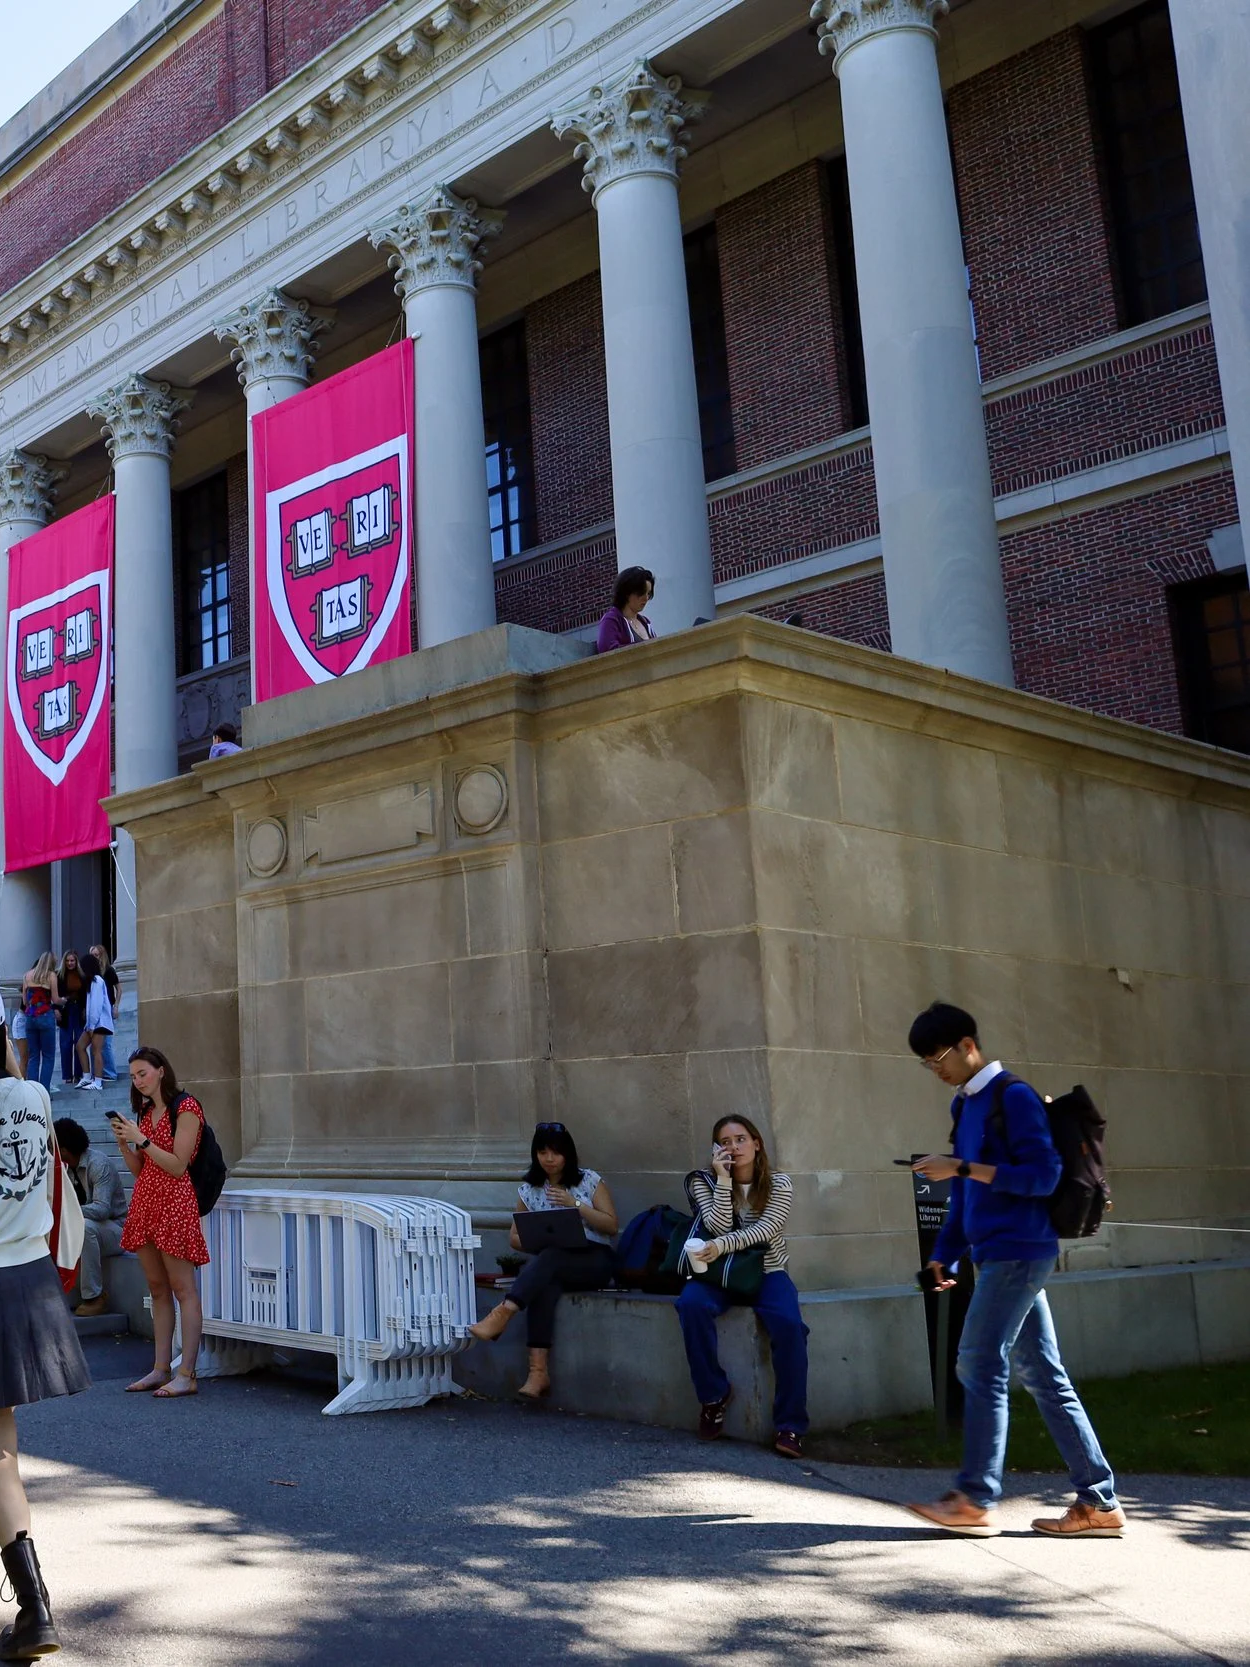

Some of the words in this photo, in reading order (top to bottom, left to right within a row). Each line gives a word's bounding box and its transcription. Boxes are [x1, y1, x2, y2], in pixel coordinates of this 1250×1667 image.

[31, 262, 209, 401] MEMORIAL
[239, 107, 431, 263] LIBRARY
[298, 527, 324, 555] VE
[356, 504, 379, 535] RI
[326, 592, 358, 624] TAS
[27, 640, 47, 662] VE
[67, 623, 83, 647] RI
[47, 696, 67, 721] TAS
[919, 1214, 941, 1223] Library
